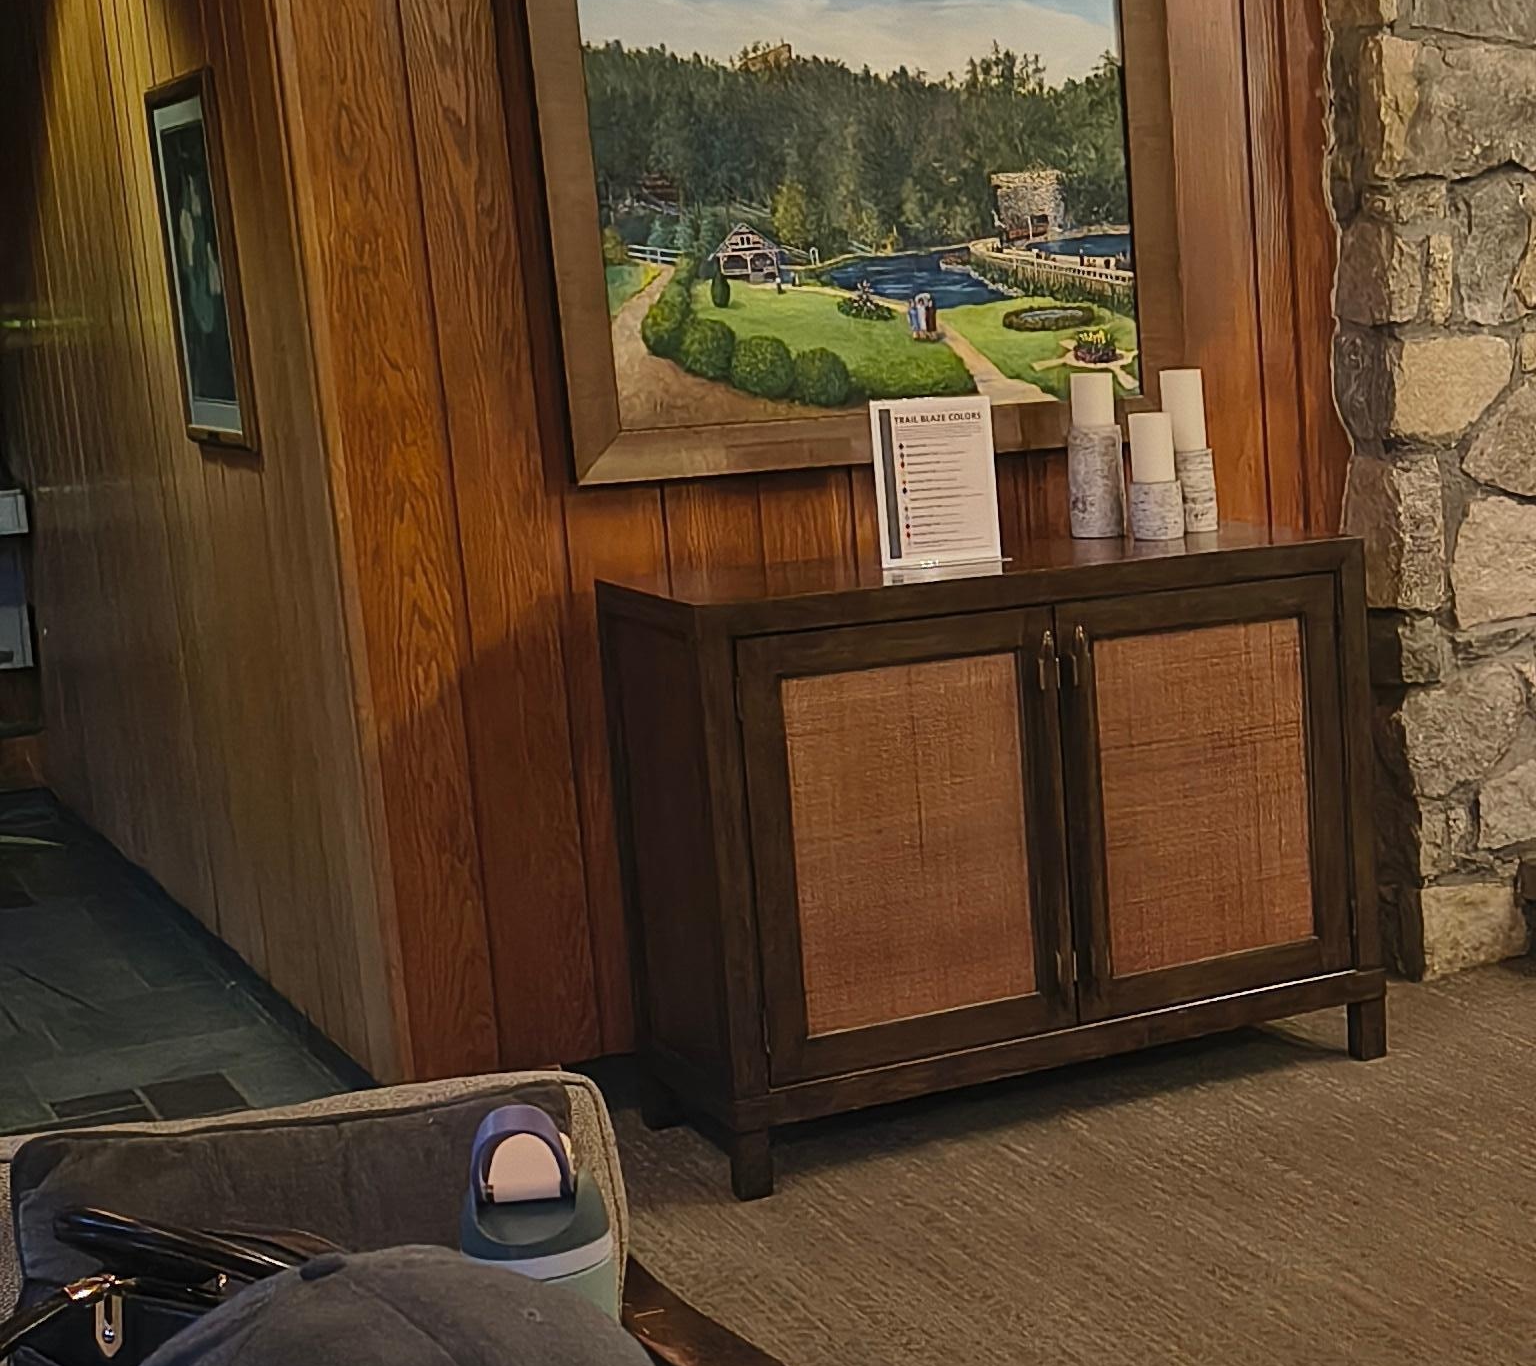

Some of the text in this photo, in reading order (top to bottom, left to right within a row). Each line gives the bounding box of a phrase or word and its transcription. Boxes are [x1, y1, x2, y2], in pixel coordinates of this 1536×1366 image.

[894, 412, 981, 424] TRAIL BLAZE COLORS
